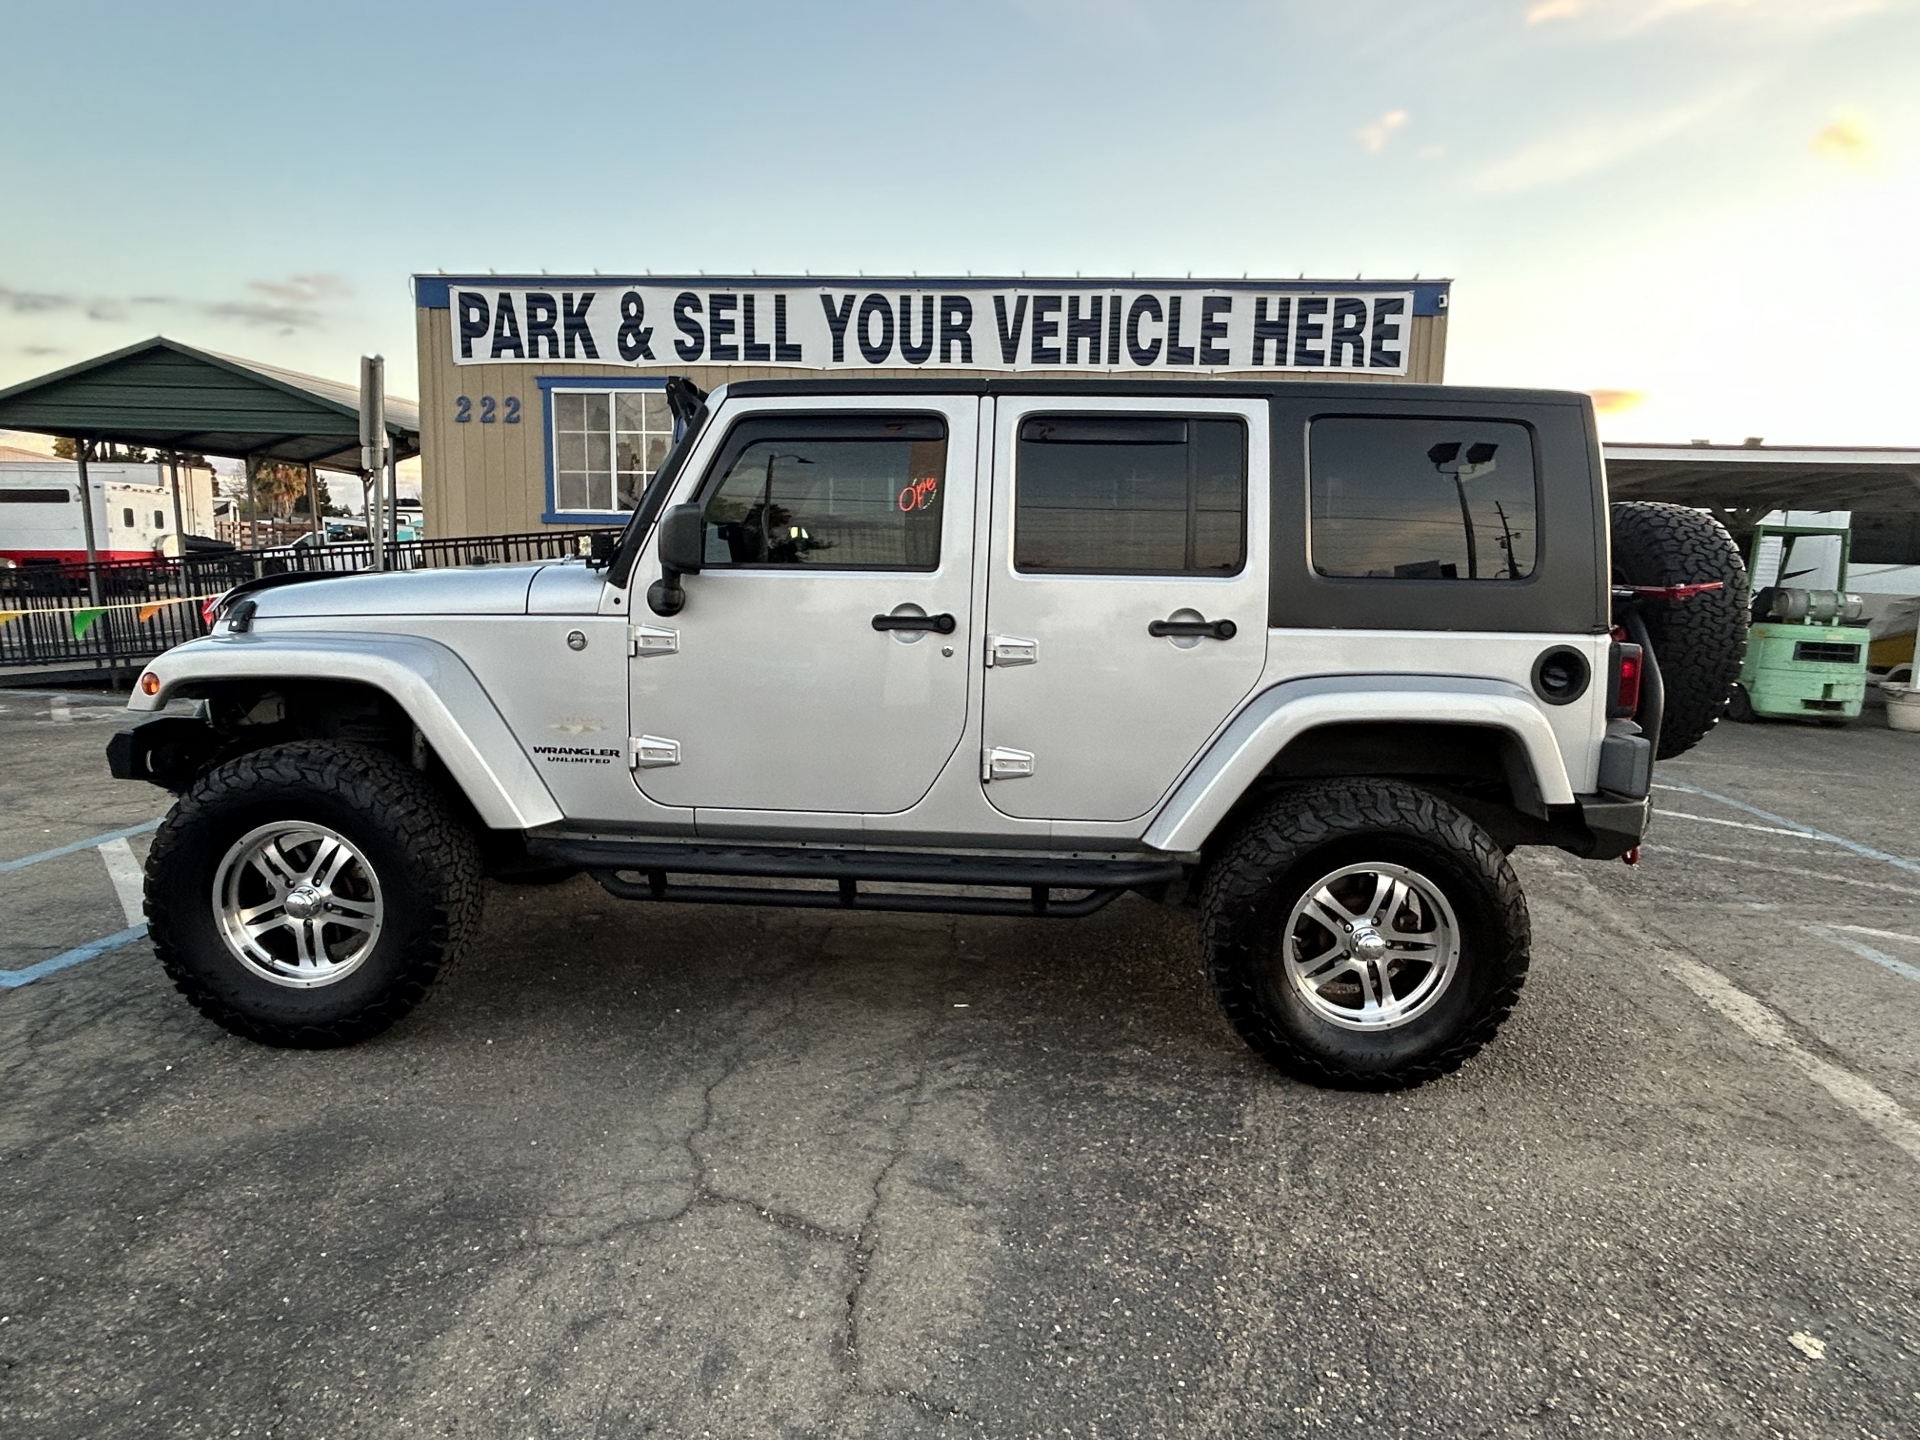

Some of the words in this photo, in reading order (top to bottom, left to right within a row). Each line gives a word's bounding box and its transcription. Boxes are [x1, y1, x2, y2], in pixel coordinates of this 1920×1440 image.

[457, 291, 601, 360] PARK
[617, 290, 657, 363] &
[673, 291, 803, 363] SELL
[819, 293, 974, 365] YOUR
[993, 294, 1233, 367] VEHICLE
[1252, 296, 1406, 368] HERE
[455, 395, 521, 424] 222
[533, 746, 621, 758] WRANGLER
[547, 756, 611, 764] UNLIMITED
